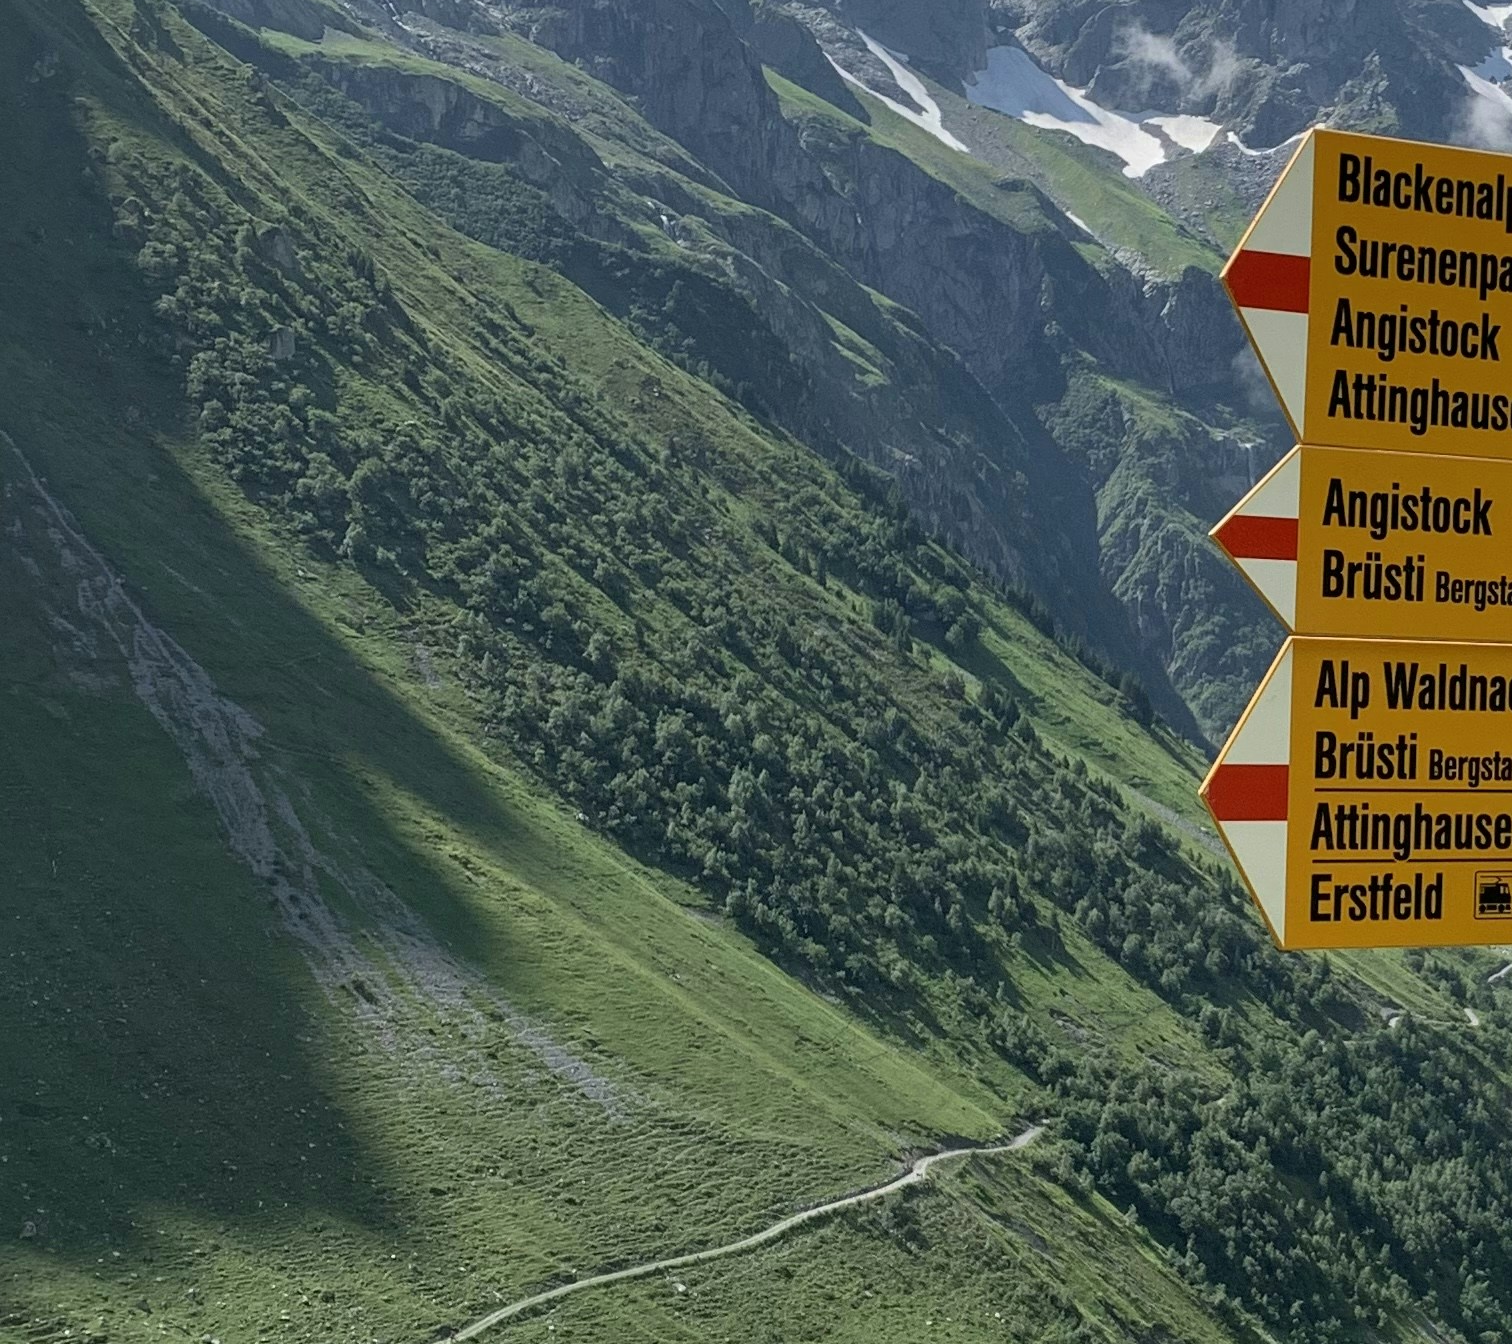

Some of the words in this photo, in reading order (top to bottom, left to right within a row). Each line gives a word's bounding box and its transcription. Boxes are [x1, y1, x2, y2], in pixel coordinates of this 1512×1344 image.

[1330, 297, 1501, 362] Angistock
[1322, 477, 1493, 541] Angistock
[1321, 548, 1425, 602] Brüsti
[1314, 659, 1370, 720] Alp
[1315, 731, 1418, 781] Brüsti
[1309, 872, 1444, 923] Erstfeld
